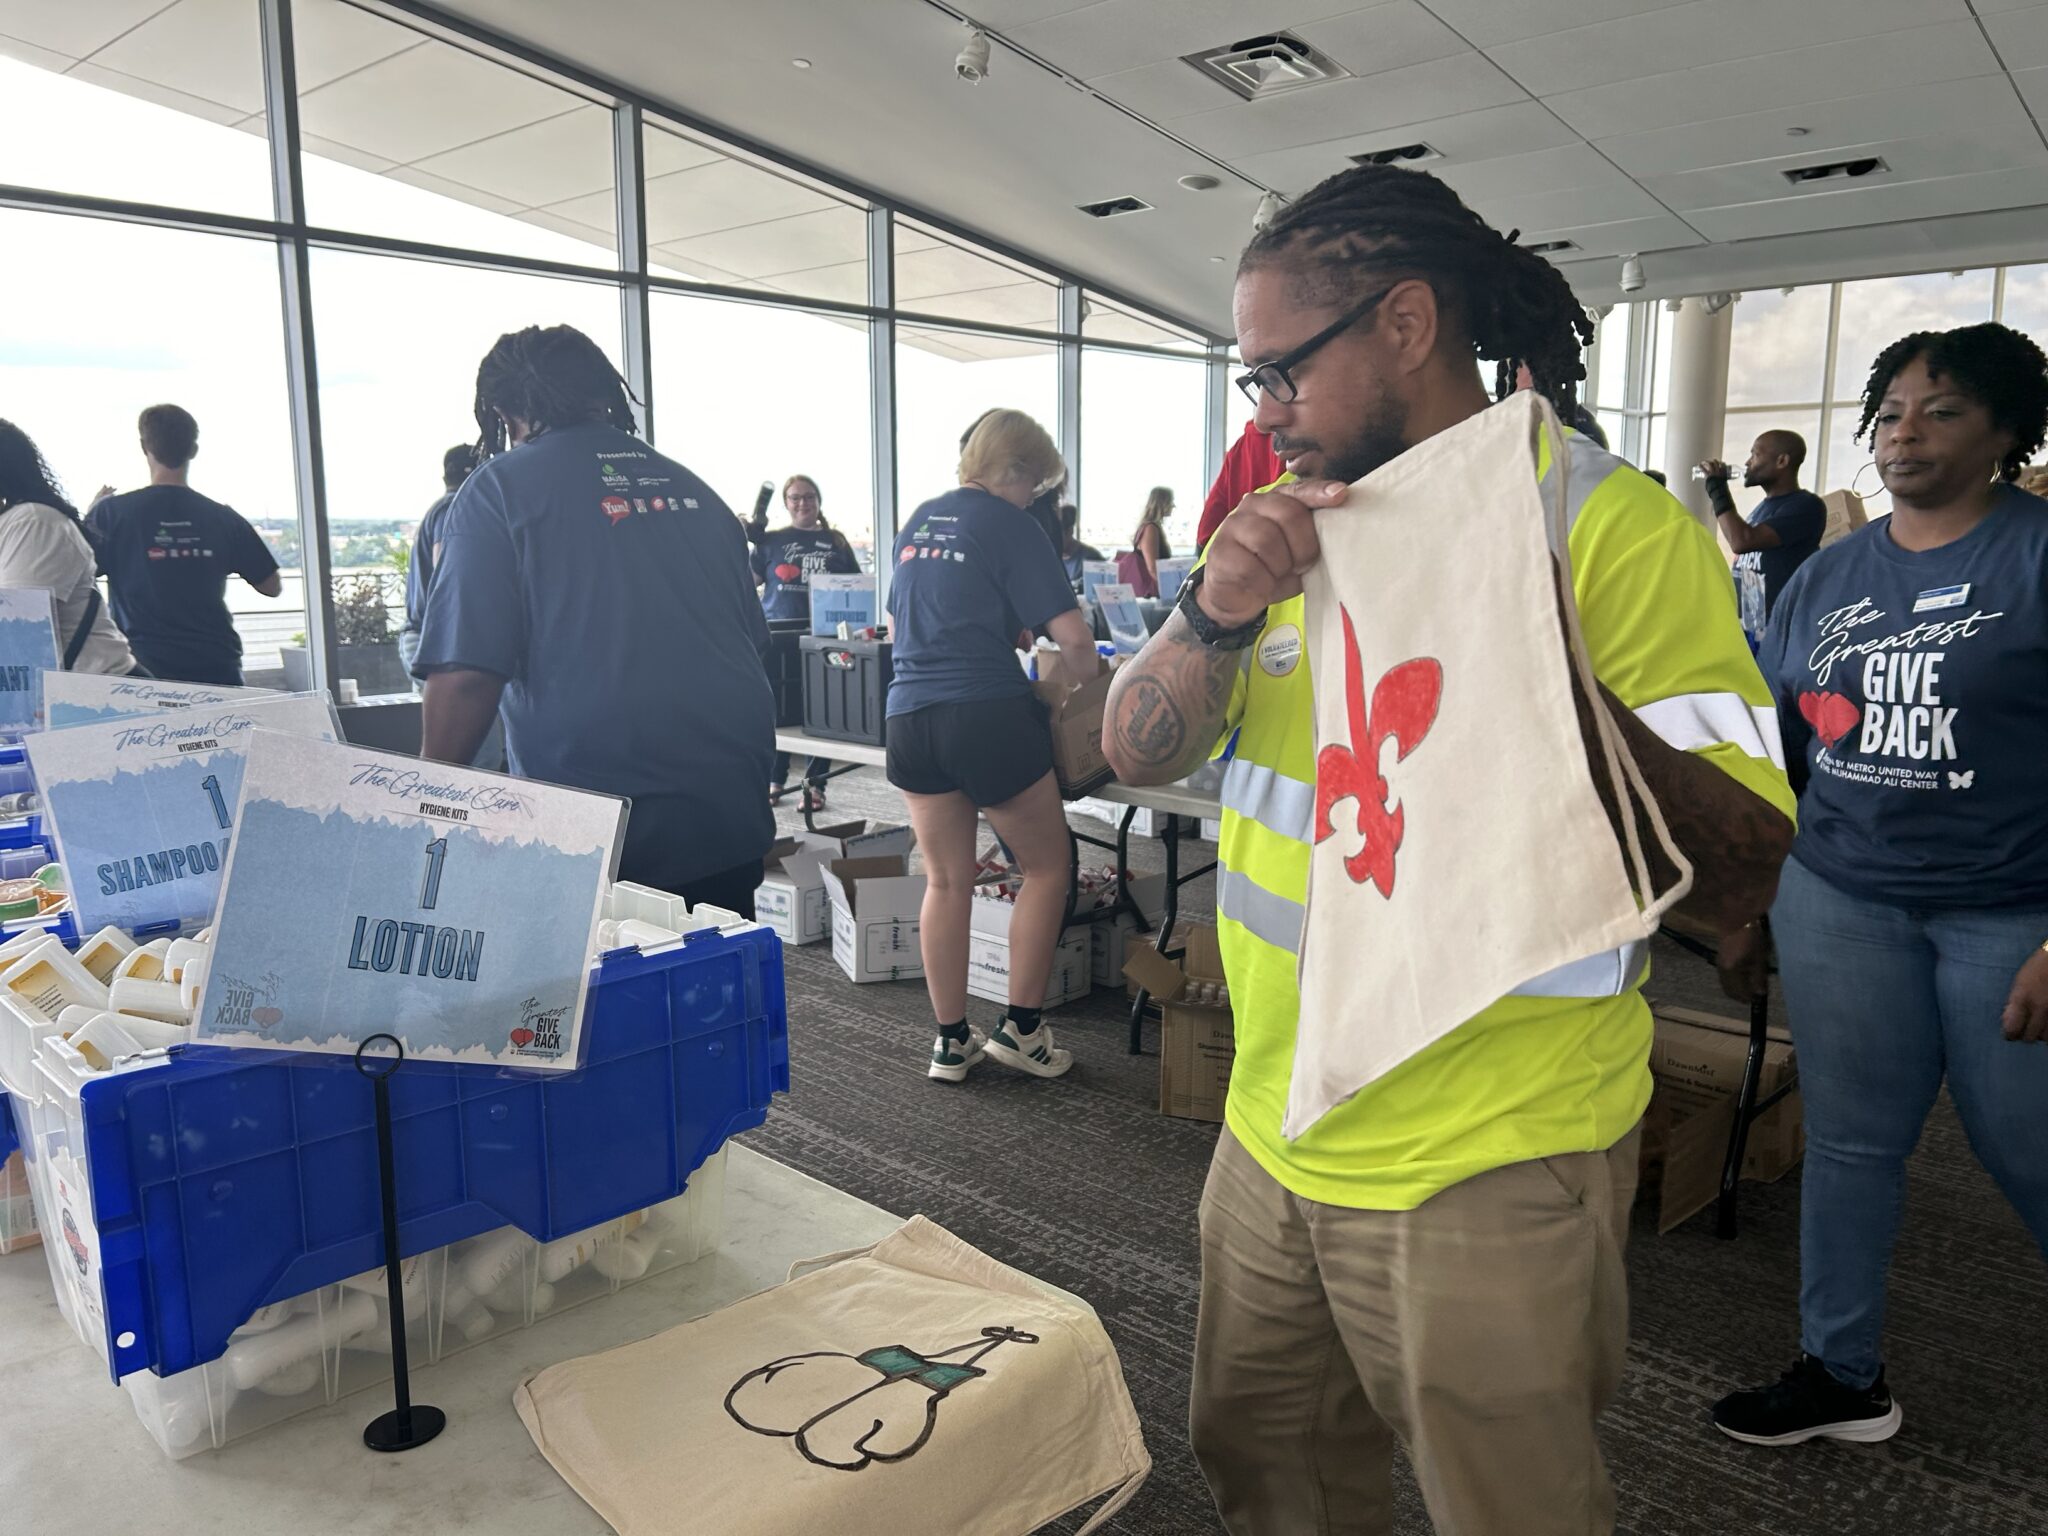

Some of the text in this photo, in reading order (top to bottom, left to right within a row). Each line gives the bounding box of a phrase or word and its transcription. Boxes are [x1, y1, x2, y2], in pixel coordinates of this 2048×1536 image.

[602, 501, 630, 515] Yum!
[802, 556, 827, 570] GIVE
[1818, 597, 1886, 636] The
[1808, 610, 2004, 686] Greatest
[1863, 652, 1945, 705] GIVE
[113, 714, 252, 750] The Greatest Care
[177, 739, 219, 753] HYGIENE KITS
[1859, 703, 1959, 760] BACK
[349, 763, 522, 811] The Greatest Care
[1831, 767, 1881, 785] MUHAMMAD
[1883, 777, 1898, 786] ALI
[1900, 779, 1939, 789] CENTER
[1847, 761, 1876, 774] METRO
[1878, 766, 1912, 779] UNITED
[1914, 771, 1939, 780] WAY
[202, 775, 233, 829] 1
[419, 802, 469, 821] HYGIENE KITS
[425, 838, 448, 910] 1
[348, 916, 485, 982] LOTION
[534, 1032, 562, 1050] BACK
[536, 1017, 560, 1034] GIVE
